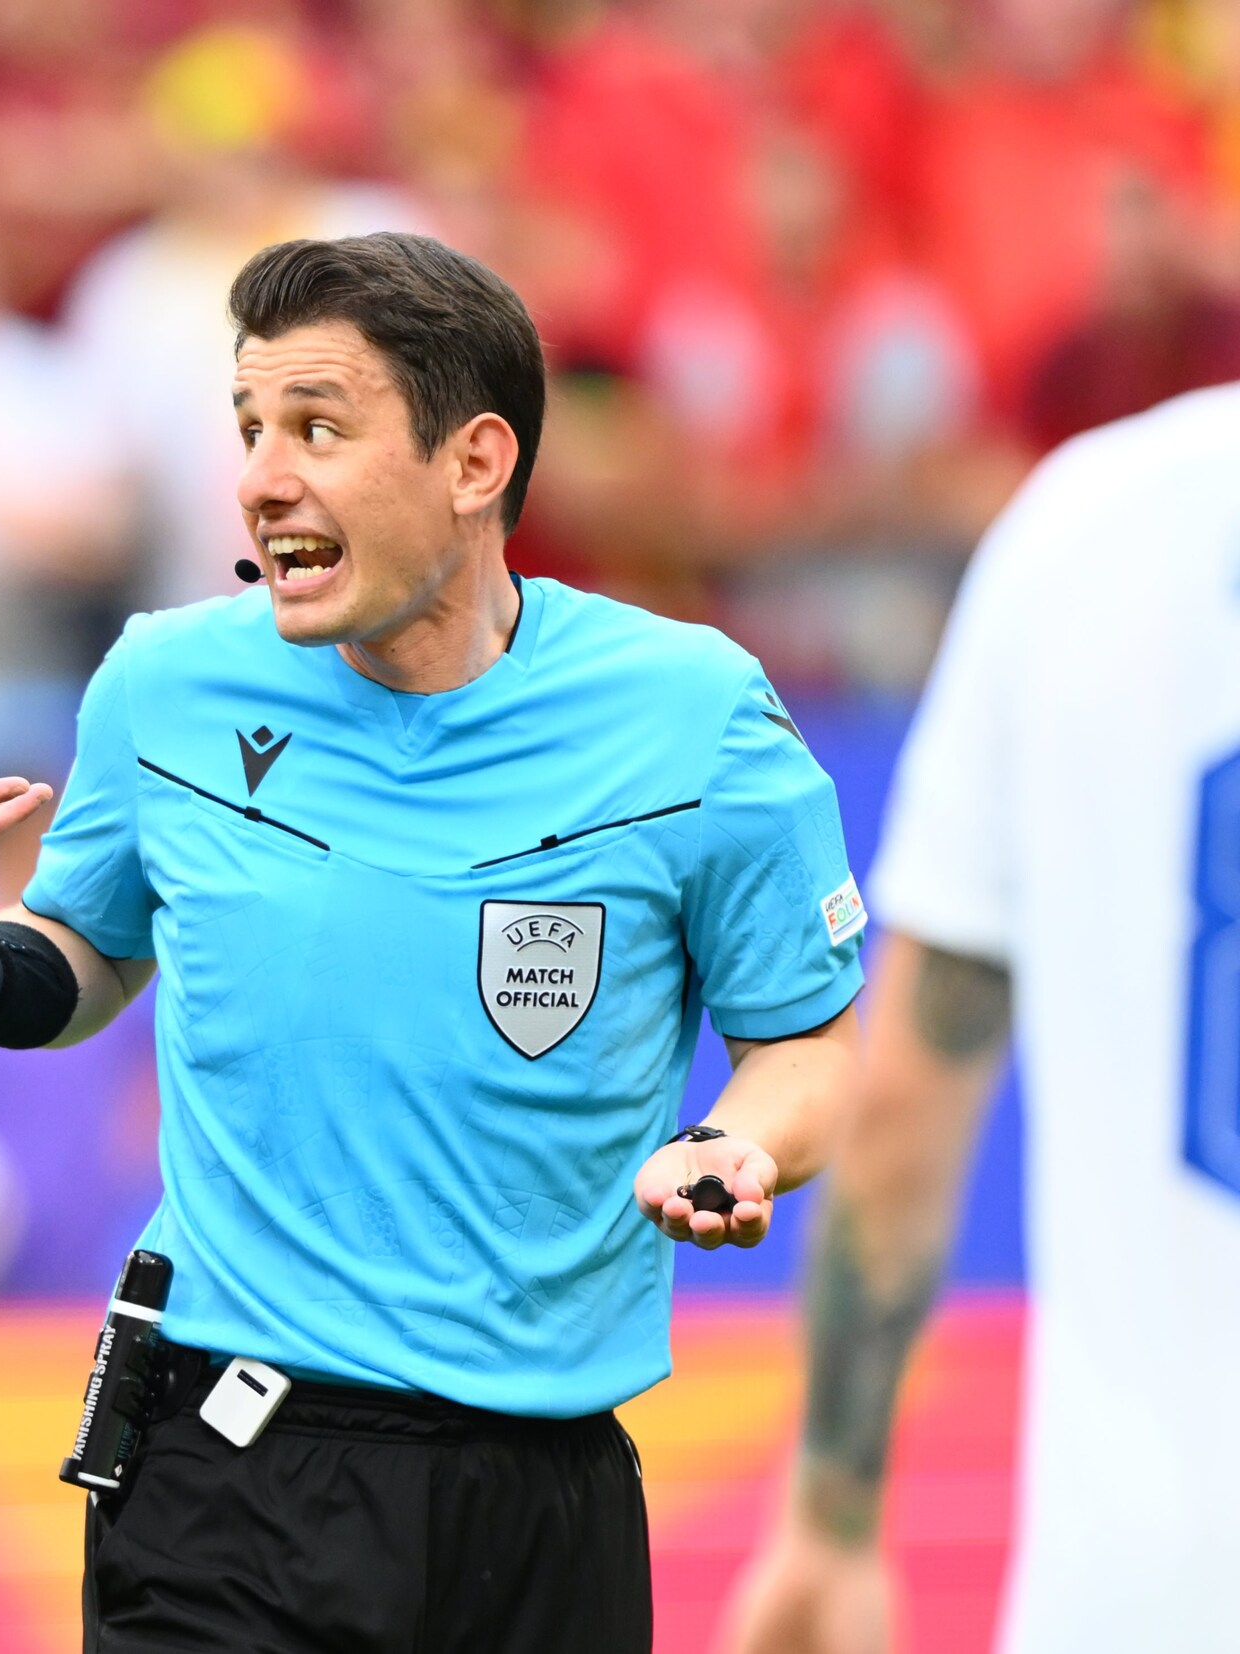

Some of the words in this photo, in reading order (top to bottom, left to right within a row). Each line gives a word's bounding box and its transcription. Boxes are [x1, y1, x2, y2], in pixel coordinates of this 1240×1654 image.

[825, 893, 843, 913] UEFA
[506, 920, 576, 948] UEFA
[505, 967, 575, 985] MATCH
[495, 990, 580, 1008] OFFICIAL
[71, 1376, 103, 1462] VANISHING
[94, 1324, 117, 1375] SPRAY
